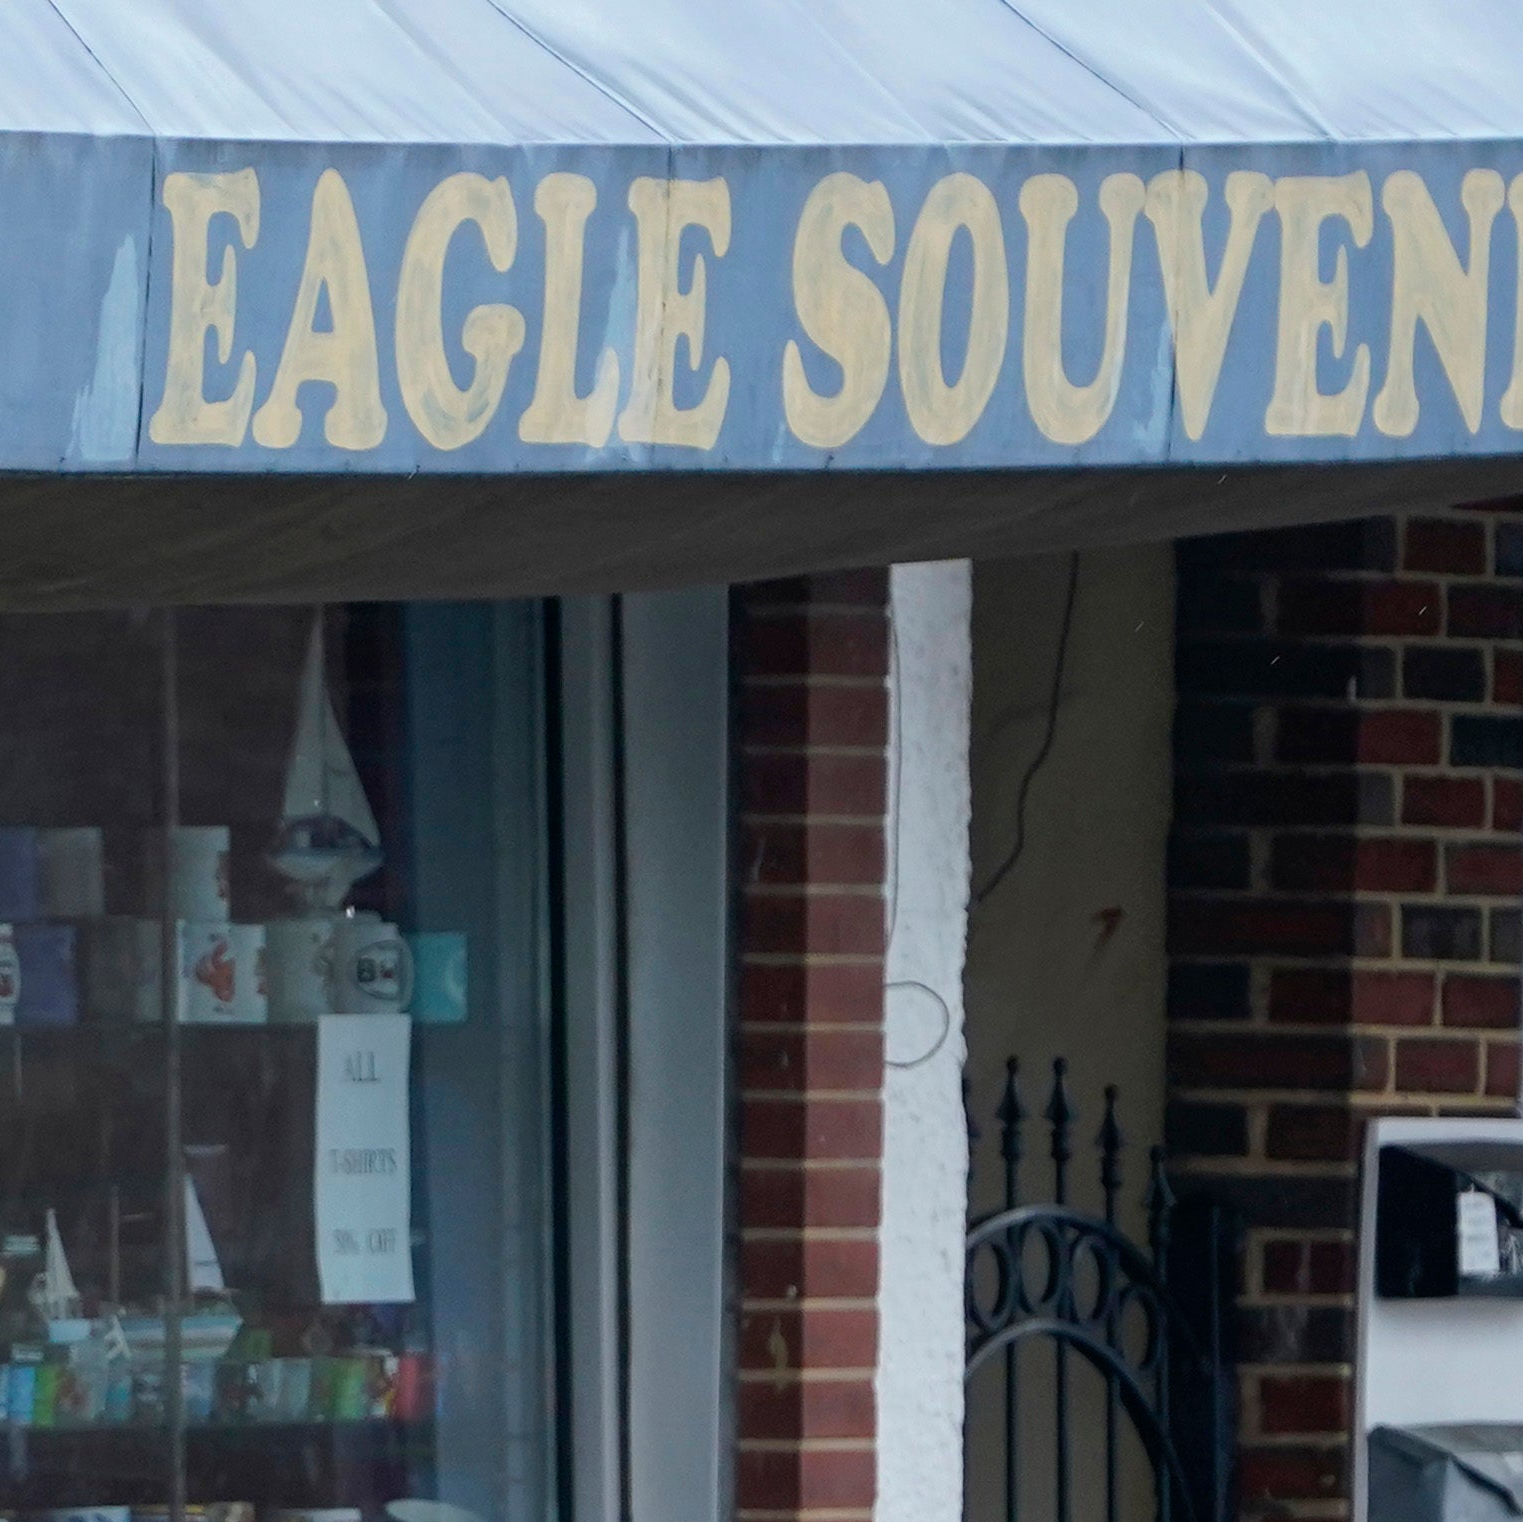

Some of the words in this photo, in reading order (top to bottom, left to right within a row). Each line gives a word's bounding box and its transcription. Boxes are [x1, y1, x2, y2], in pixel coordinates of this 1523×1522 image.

[149, 167, 732, 452] EAGLE
[341, 1050, 382, 1083] ALL
[330, 1149, 399, 1175] T-SHIRTS
